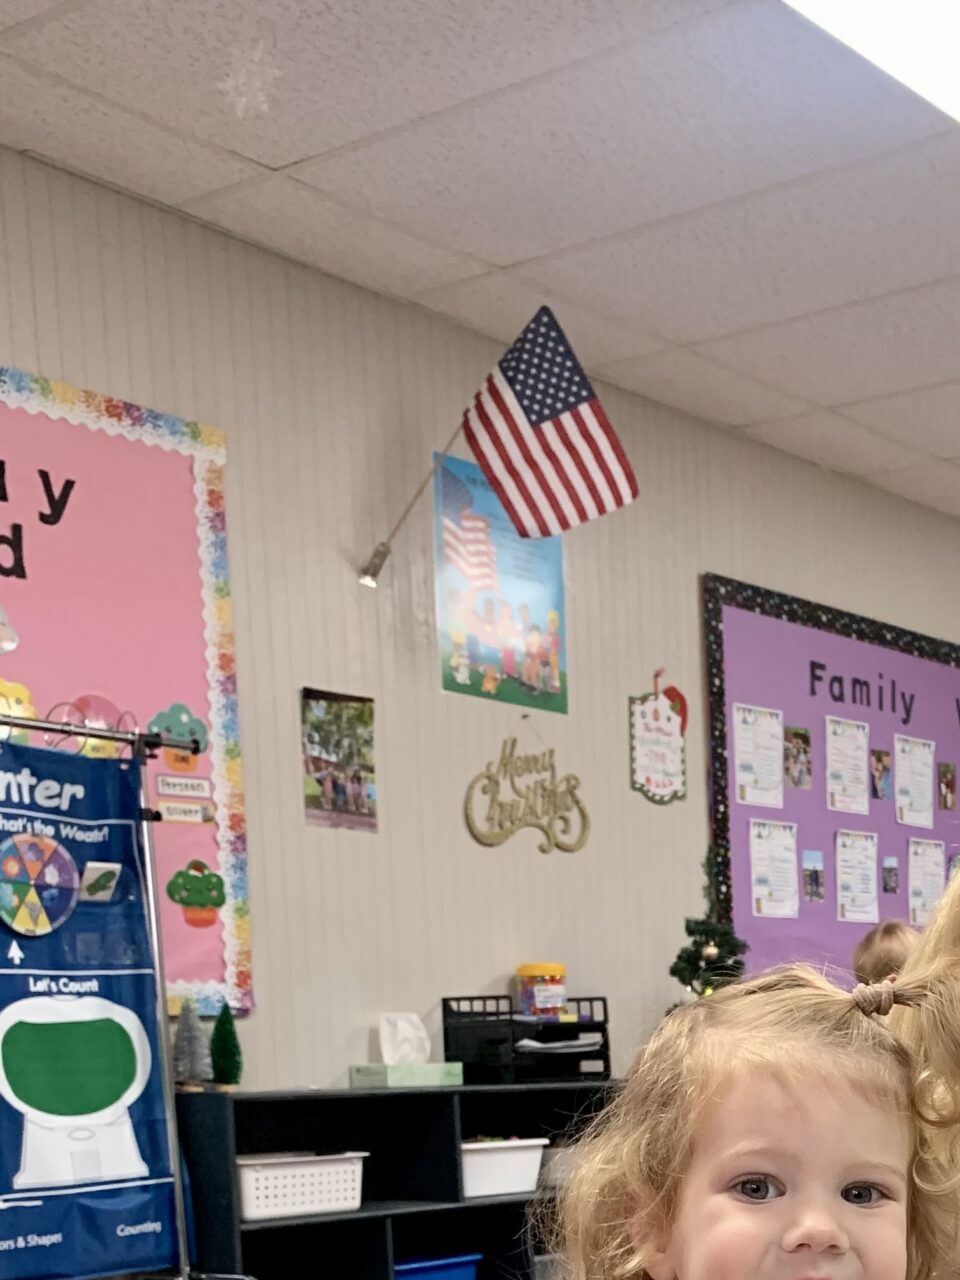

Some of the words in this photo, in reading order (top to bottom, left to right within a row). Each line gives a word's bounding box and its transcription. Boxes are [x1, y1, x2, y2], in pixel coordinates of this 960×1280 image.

[809, 659, 916, 726] Family
[486, 737, 556, 784] Merry
[29, 975, 57, 993] Let's
[59, 976, 99, 993] Count
[116, 1220, 162, 1237] Counting
[16, 1235, 26, 1249] &
[27, 1232, 63, 1248] Shapes
